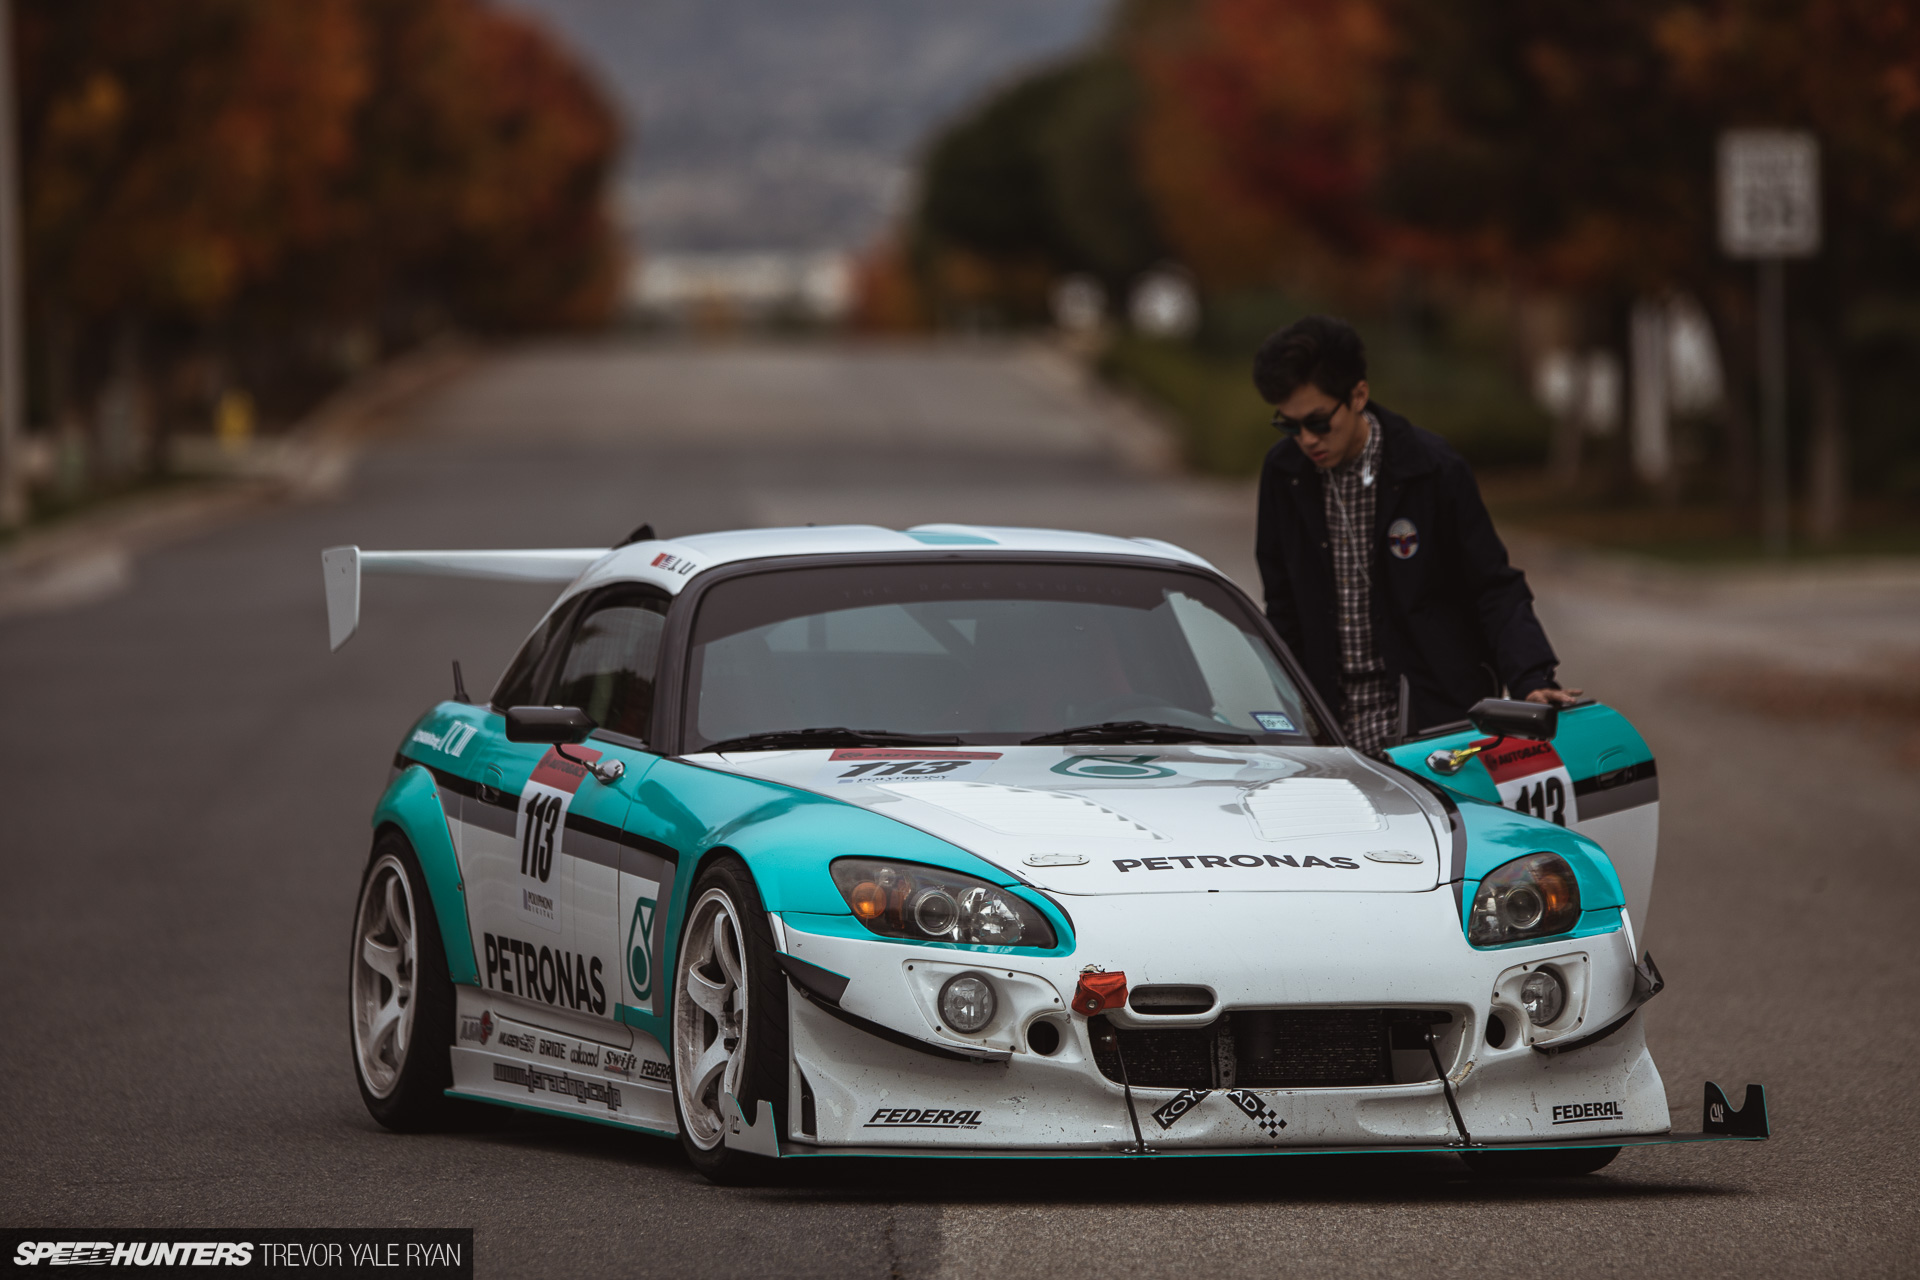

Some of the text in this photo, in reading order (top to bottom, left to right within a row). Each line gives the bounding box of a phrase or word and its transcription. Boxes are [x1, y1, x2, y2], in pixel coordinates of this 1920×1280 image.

[1497, 743, 1552, 766] AUTOBACS
[836, 760, 972, 779] 113
[520, 792, 563, 884] 113
[1112, 854, 1361, 873] PETRONAS
[483, 932, 607, 1016] PETRONAS
[539, 1038, 567, 1060] BRIDE
[604, 1050, 638, 1070] Swift
[641, 1059, 672, 1080] FEDERA
[868, 1108, 982, 1125] FEDERAL
[1552, 1101, 1623, 1120] FEDERAL
